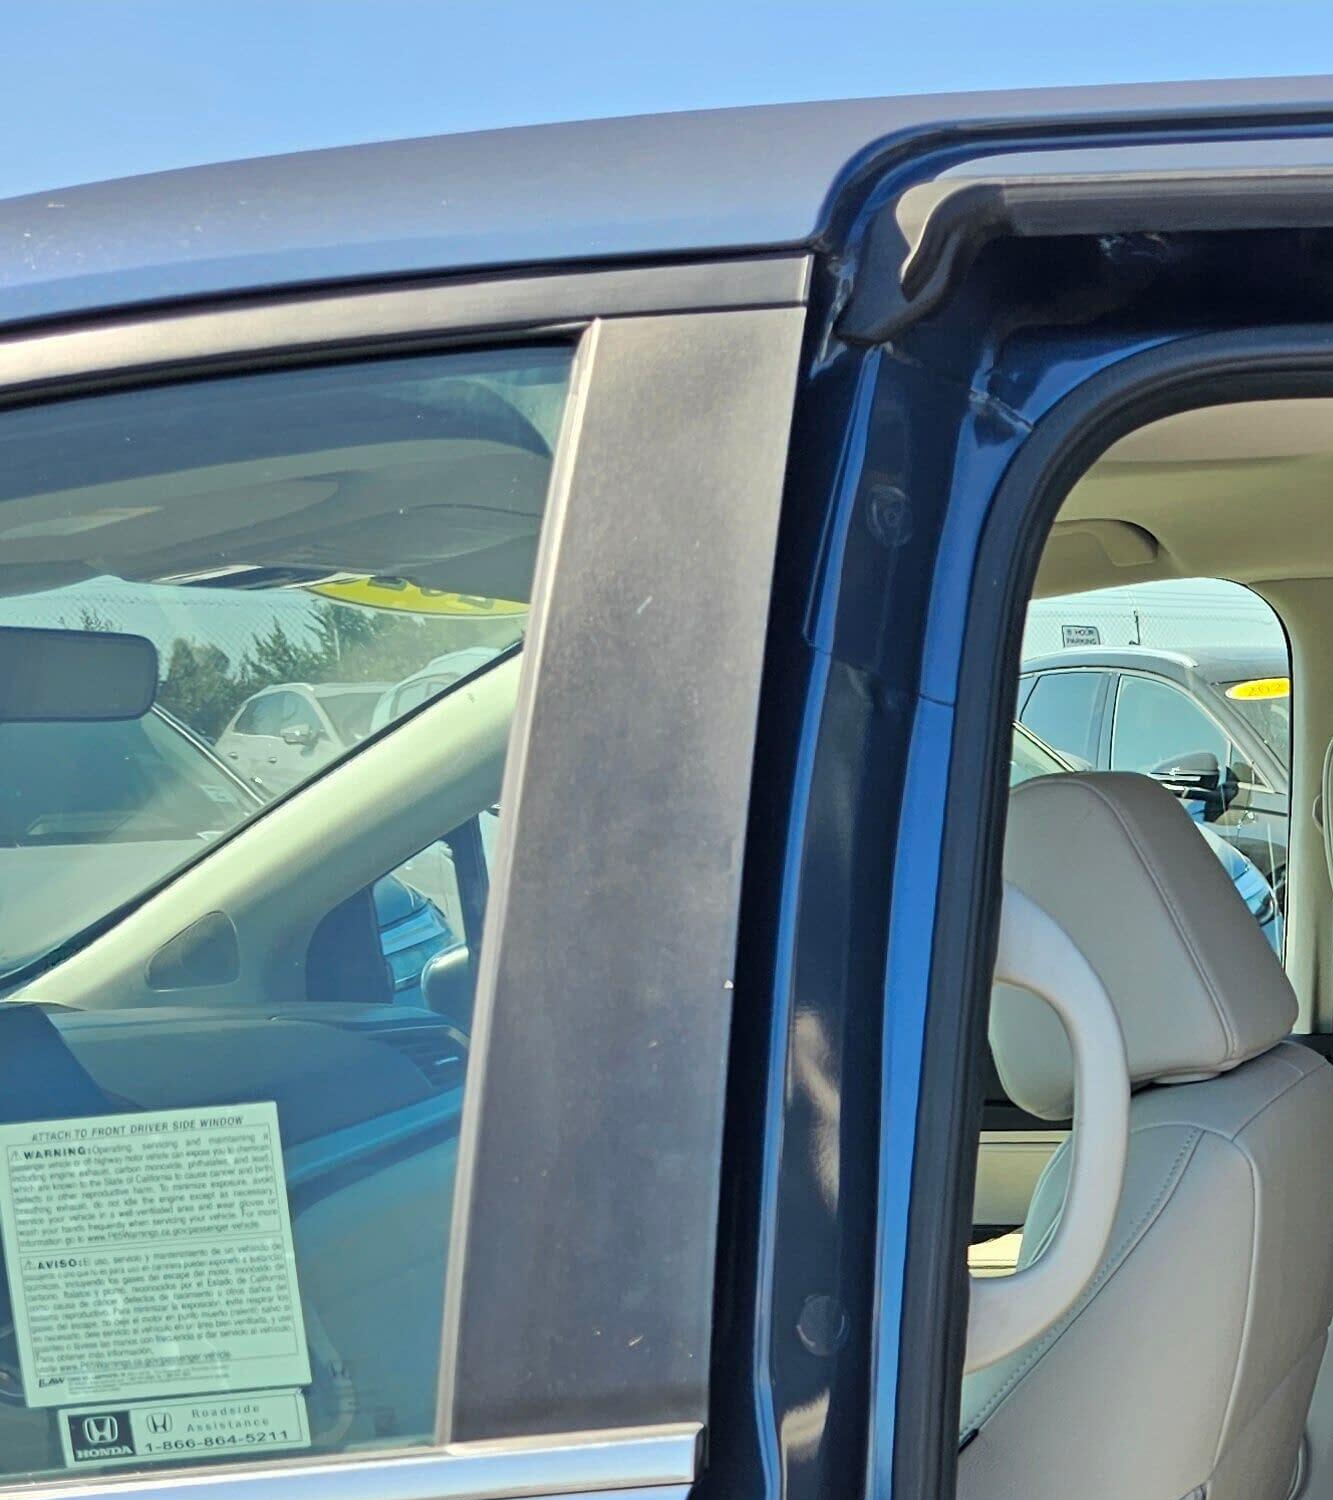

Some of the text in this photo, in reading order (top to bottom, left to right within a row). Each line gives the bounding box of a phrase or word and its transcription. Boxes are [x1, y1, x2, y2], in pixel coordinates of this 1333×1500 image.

[32, 1116, 243, 1141] ATTACH TO FRONT DRIVER SIDE WINDOW
[192, 1405, 260, 1418] Roadside
[187, 1419, 269, 1433] Assistance
[146, 1430, 288, 1452] 1-866-864-5211
[77, 1444, 133, 1459] HONDA
